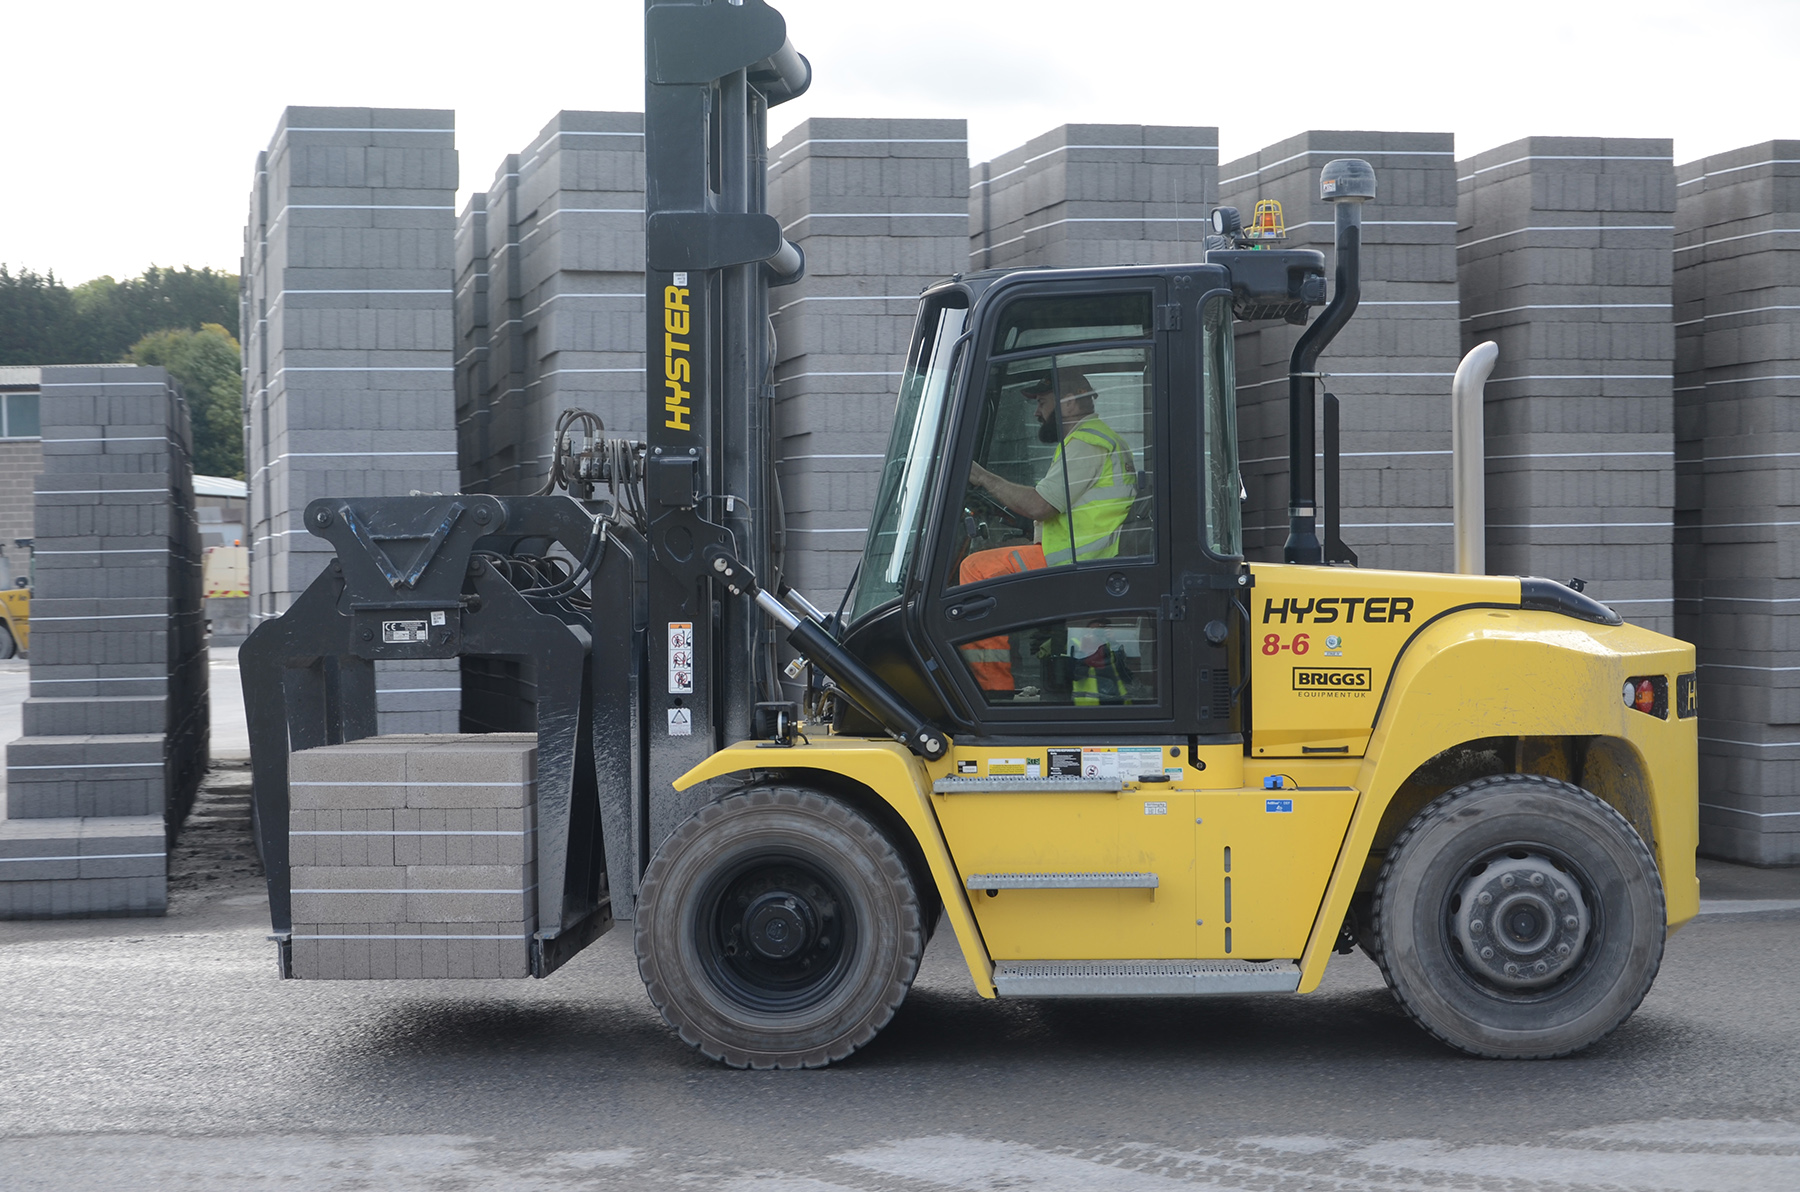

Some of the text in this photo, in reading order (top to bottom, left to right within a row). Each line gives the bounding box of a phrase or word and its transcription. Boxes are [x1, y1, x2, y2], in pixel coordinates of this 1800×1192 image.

[664, 285, 690, 431] HYSTER
[1262, 597, 1414, 624] HYSTER
[1262, 633, 1310, 656] 8-6
[1298, 672, 1366, 686] BRIGGS
